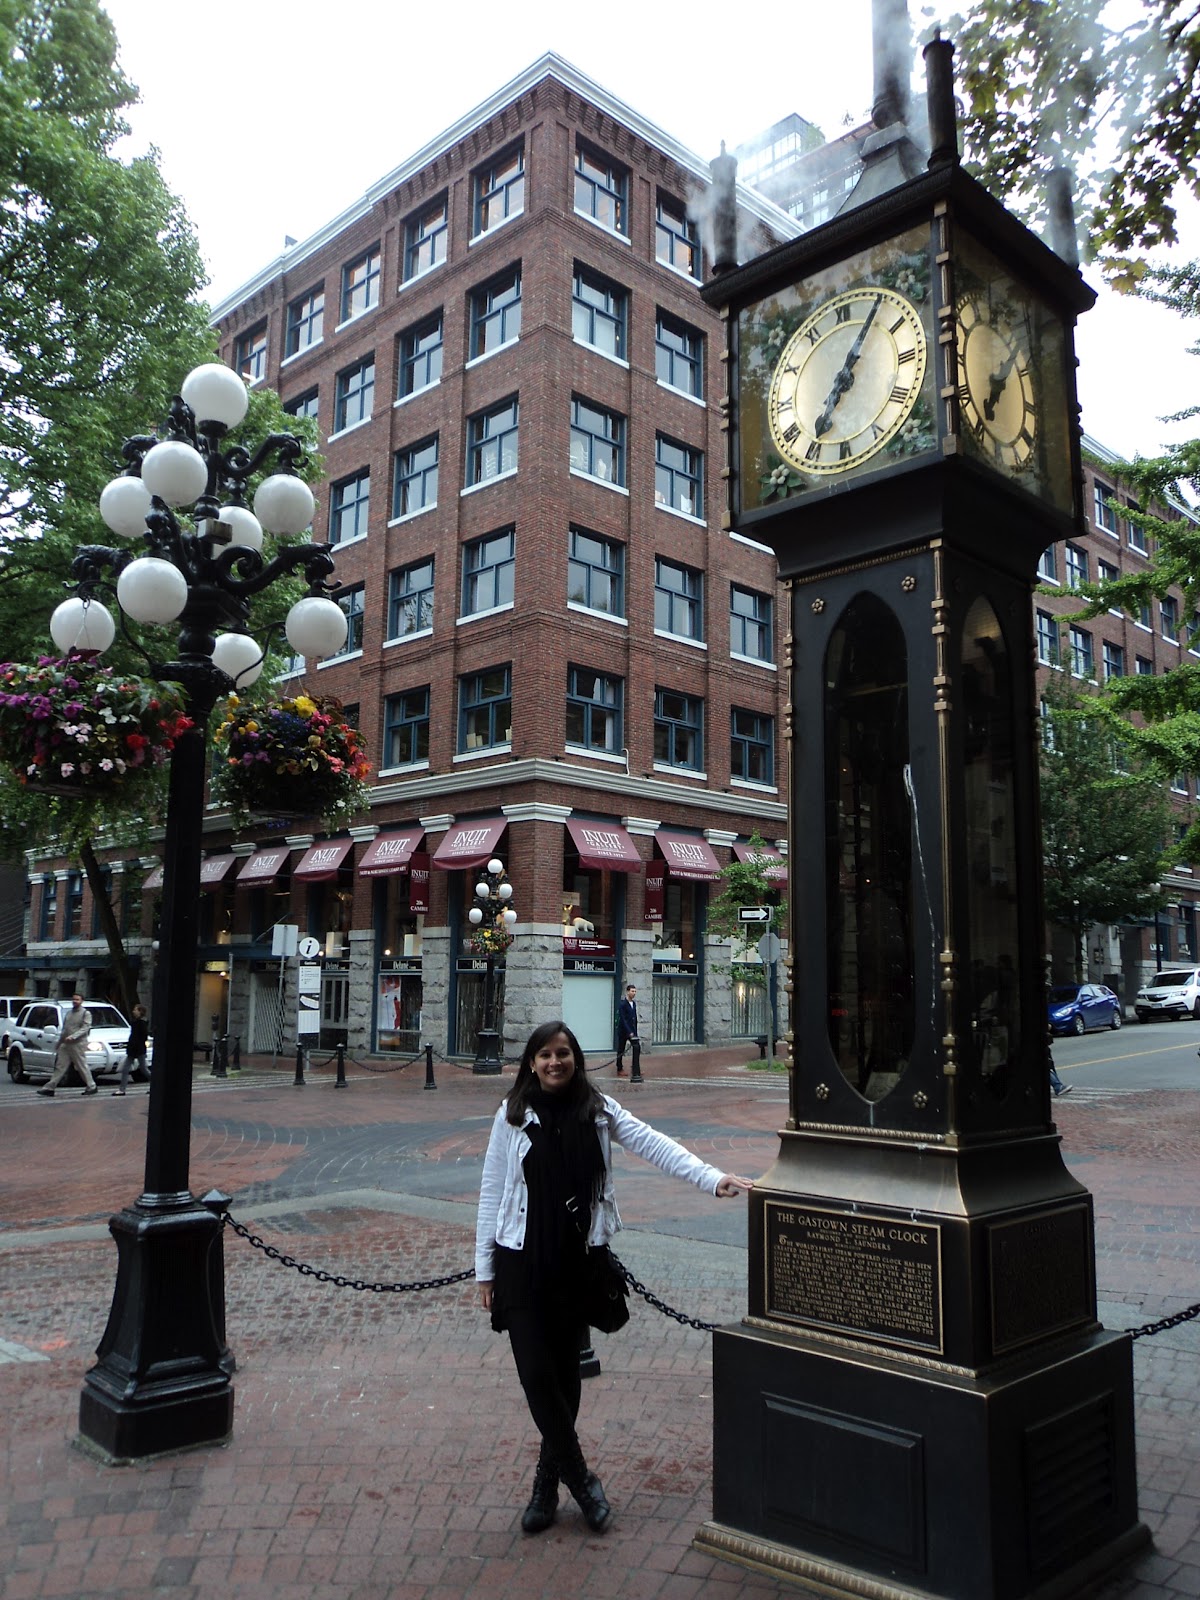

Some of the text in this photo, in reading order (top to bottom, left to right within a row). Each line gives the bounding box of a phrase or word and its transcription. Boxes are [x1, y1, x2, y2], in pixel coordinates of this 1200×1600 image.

[898, 347, 916, 365] III
[453, 828, 492, 844] INUIT
[581, 829, 621, 846] INUIT
[377, 838, 411, 853] INUIT
[589, 841, 622, 850] GALLERY
[668, 842, 704, 858] INUIT
[311, 847, 342, 861] INUIT
[676, 853, 704, 861] GALLERY
[252, 855, 280, 867] INUIT
[411, 869, 430, 878] INUIT
[646, 877, 663, 886] INUIT
[472, 959, 488, 969] Delan
[777, 1213, 928, 1244] THE GASTOWN STEAM CLOCK
[807, 1232, 841, 1243] RAYMOND
[854, 1239, 890, 1251] SAUNDERS
[882, 1257, 902, 1265] CLOCK
[918, 1269, 932, 1277] LIVE
